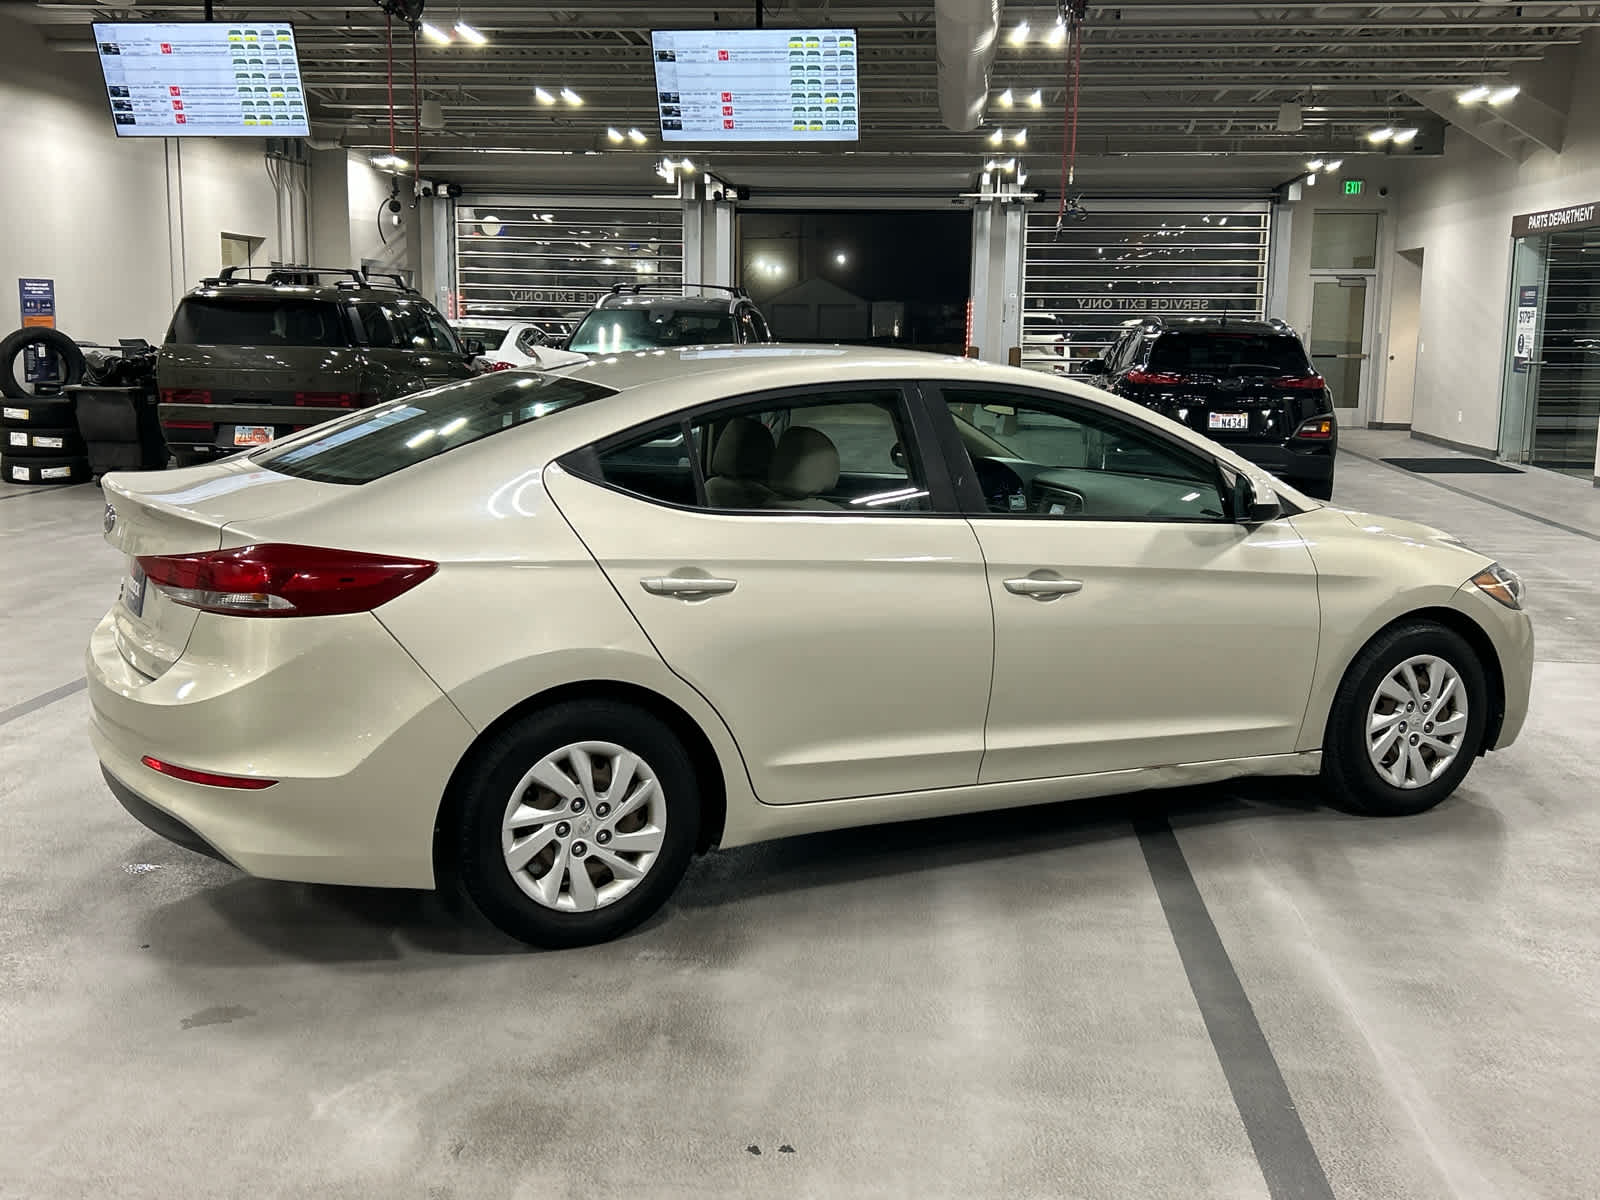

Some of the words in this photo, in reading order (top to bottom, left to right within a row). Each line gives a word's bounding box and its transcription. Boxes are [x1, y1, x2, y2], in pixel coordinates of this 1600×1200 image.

[1345, 180, 1362, 194] EXIT
[1527, 214, 1548, 229] PARTS
[1548, 206, 1595, 226] DEPARTMENT
